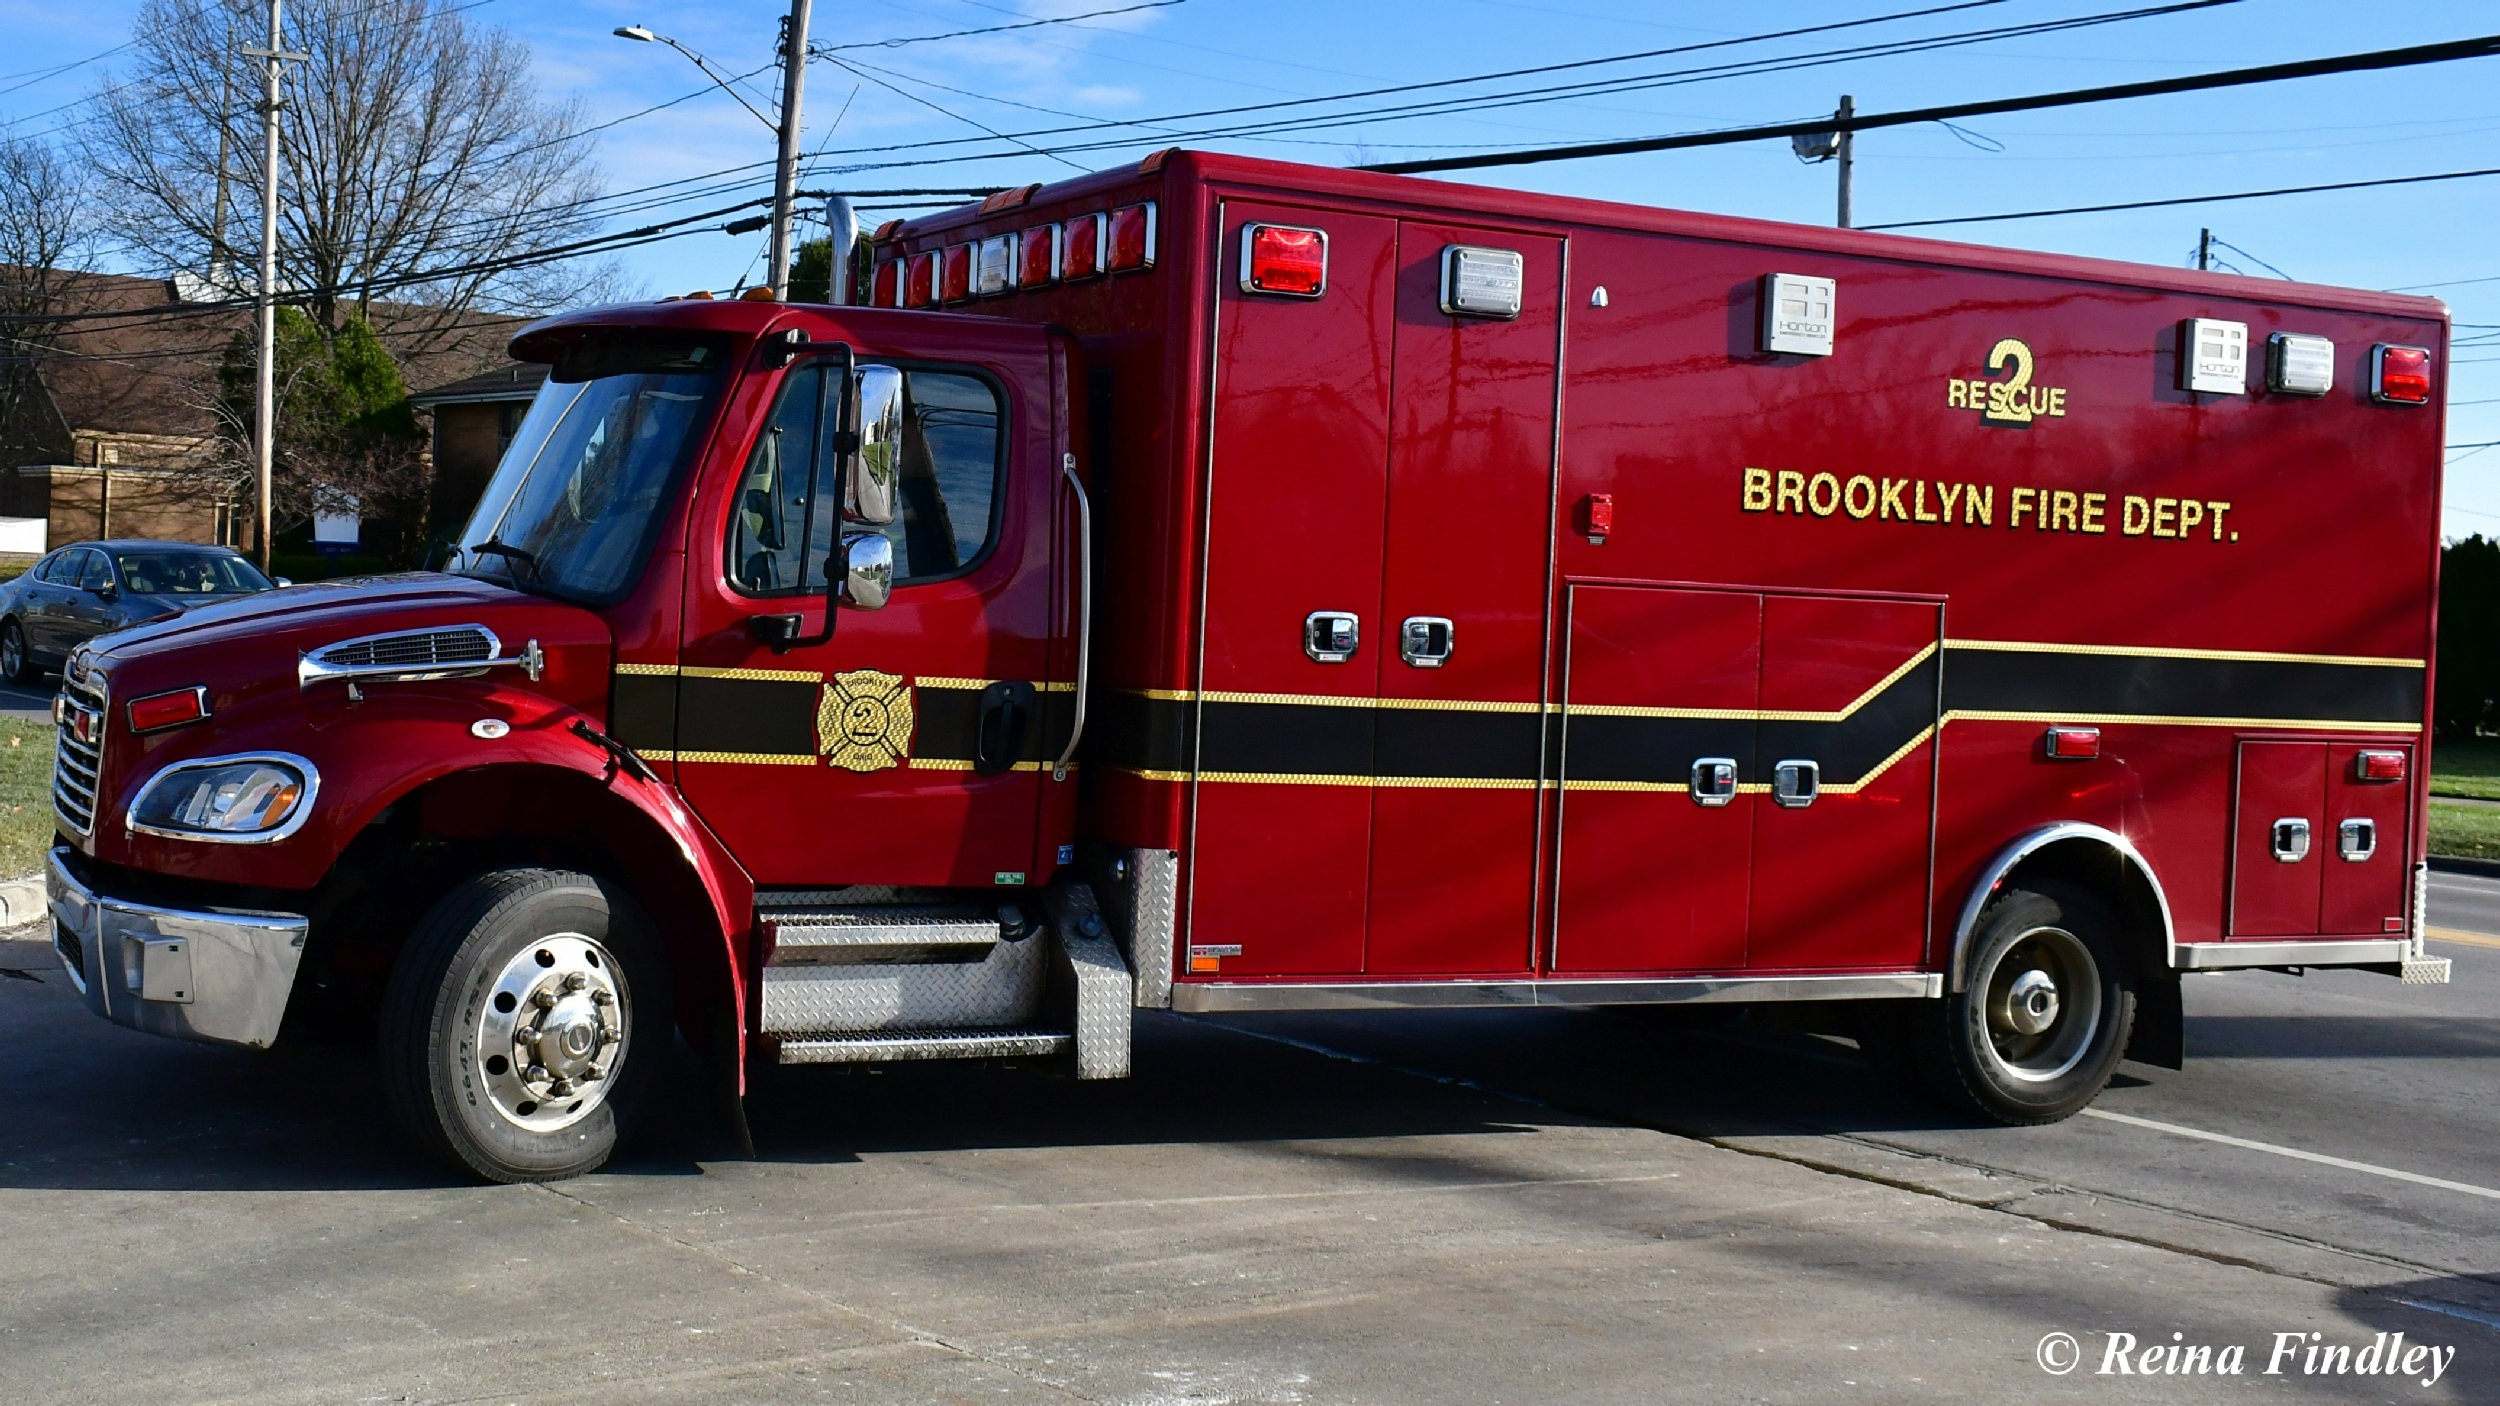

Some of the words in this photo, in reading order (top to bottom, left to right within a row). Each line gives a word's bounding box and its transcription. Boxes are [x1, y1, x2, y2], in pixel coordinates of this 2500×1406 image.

[1779, 321, 1827, 333] Horton
[1947, 378, 2067, 417] RESCUE
[1985, 338, 2034, 422] 2
[1742, 467, 1994, 527] BROOKLYN
[2010, 486, 2107, 534] FIRE
[2121, 494, 2240, 543] DEPT.
[852, 701, 878, 737] 2
[852, 753, 873, 761] OHIO
